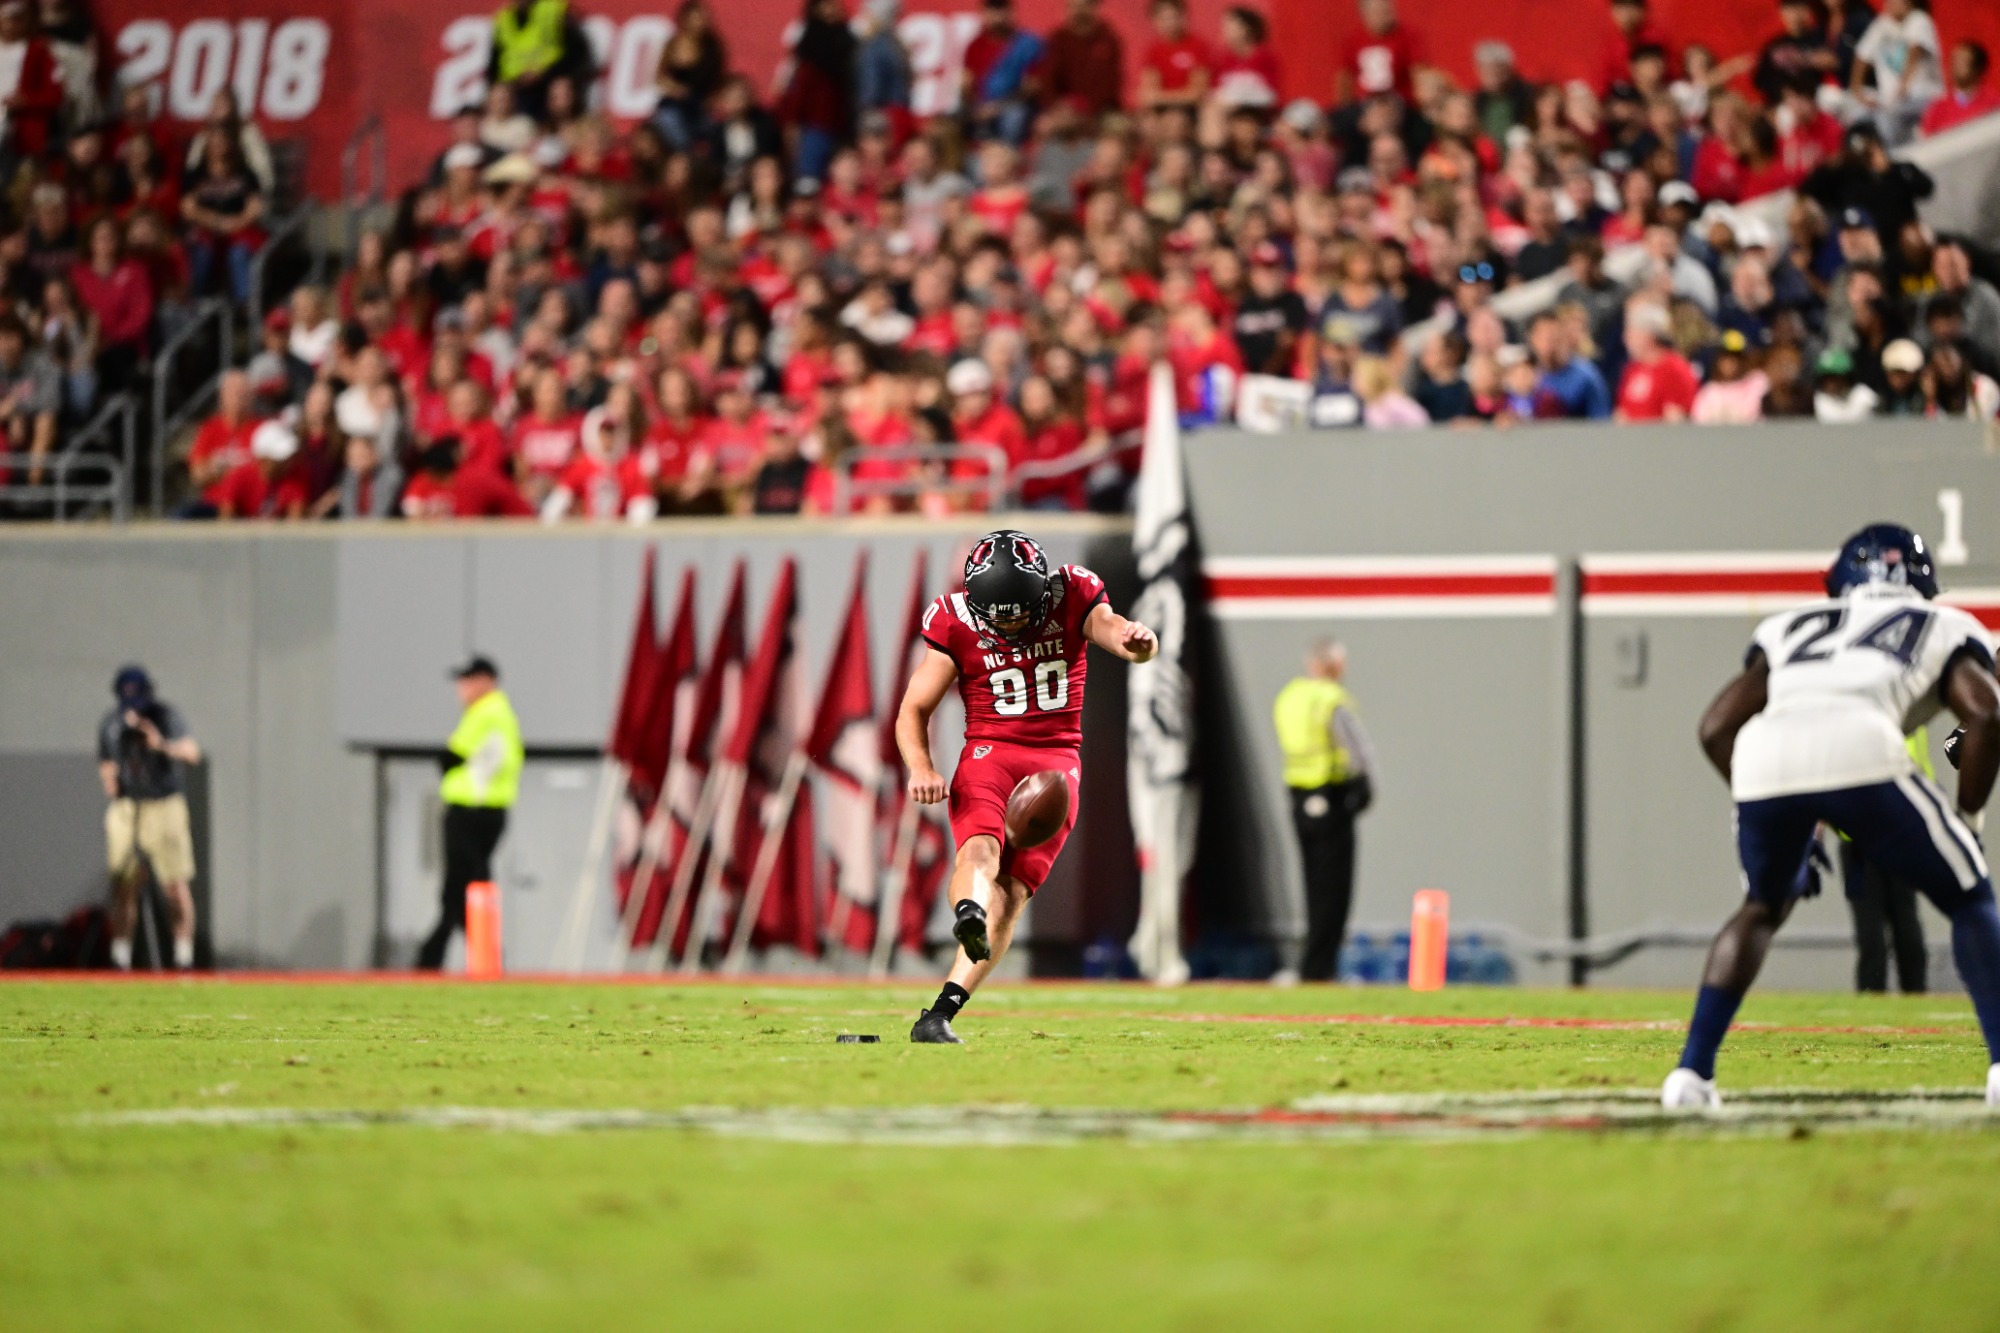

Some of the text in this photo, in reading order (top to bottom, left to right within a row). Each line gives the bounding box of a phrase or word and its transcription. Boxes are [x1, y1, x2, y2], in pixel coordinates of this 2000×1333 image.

[115, 17, 331, 121] 2018
[430, 15, 677, 119] 20
[1937, 488, 1968, 565] 1
[983, 639, 1064, 670] NC STATE
[1784, 606, 1935, 670] 24
[989, 659, 1069, 715] 90
